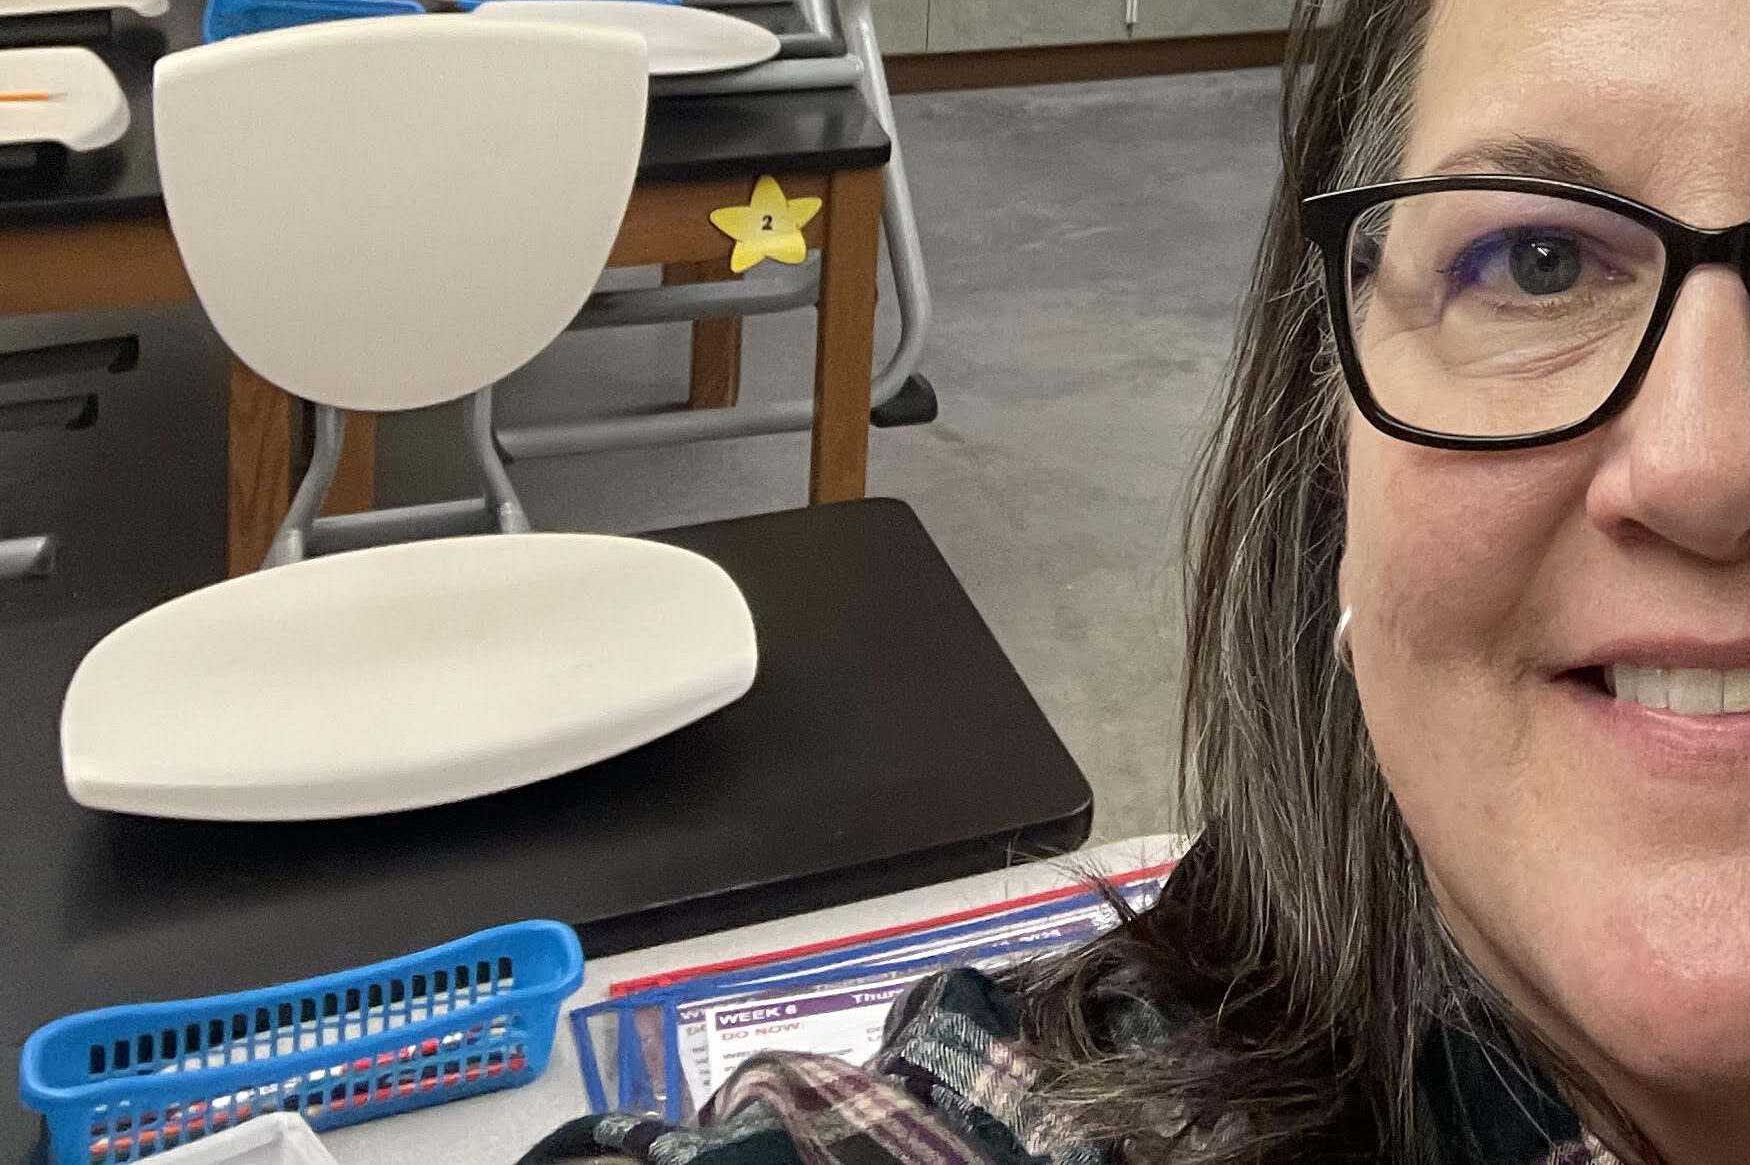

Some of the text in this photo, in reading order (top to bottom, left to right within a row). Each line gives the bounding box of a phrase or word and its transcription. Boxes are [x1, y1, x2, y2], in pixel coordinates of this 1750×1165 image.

[761, 214, 774, 231] 2
[718, 1007, 781, 1026] WEEK
[785, 1003, 797, 1015] 6
[721, 1030, 749, 1041] DO
